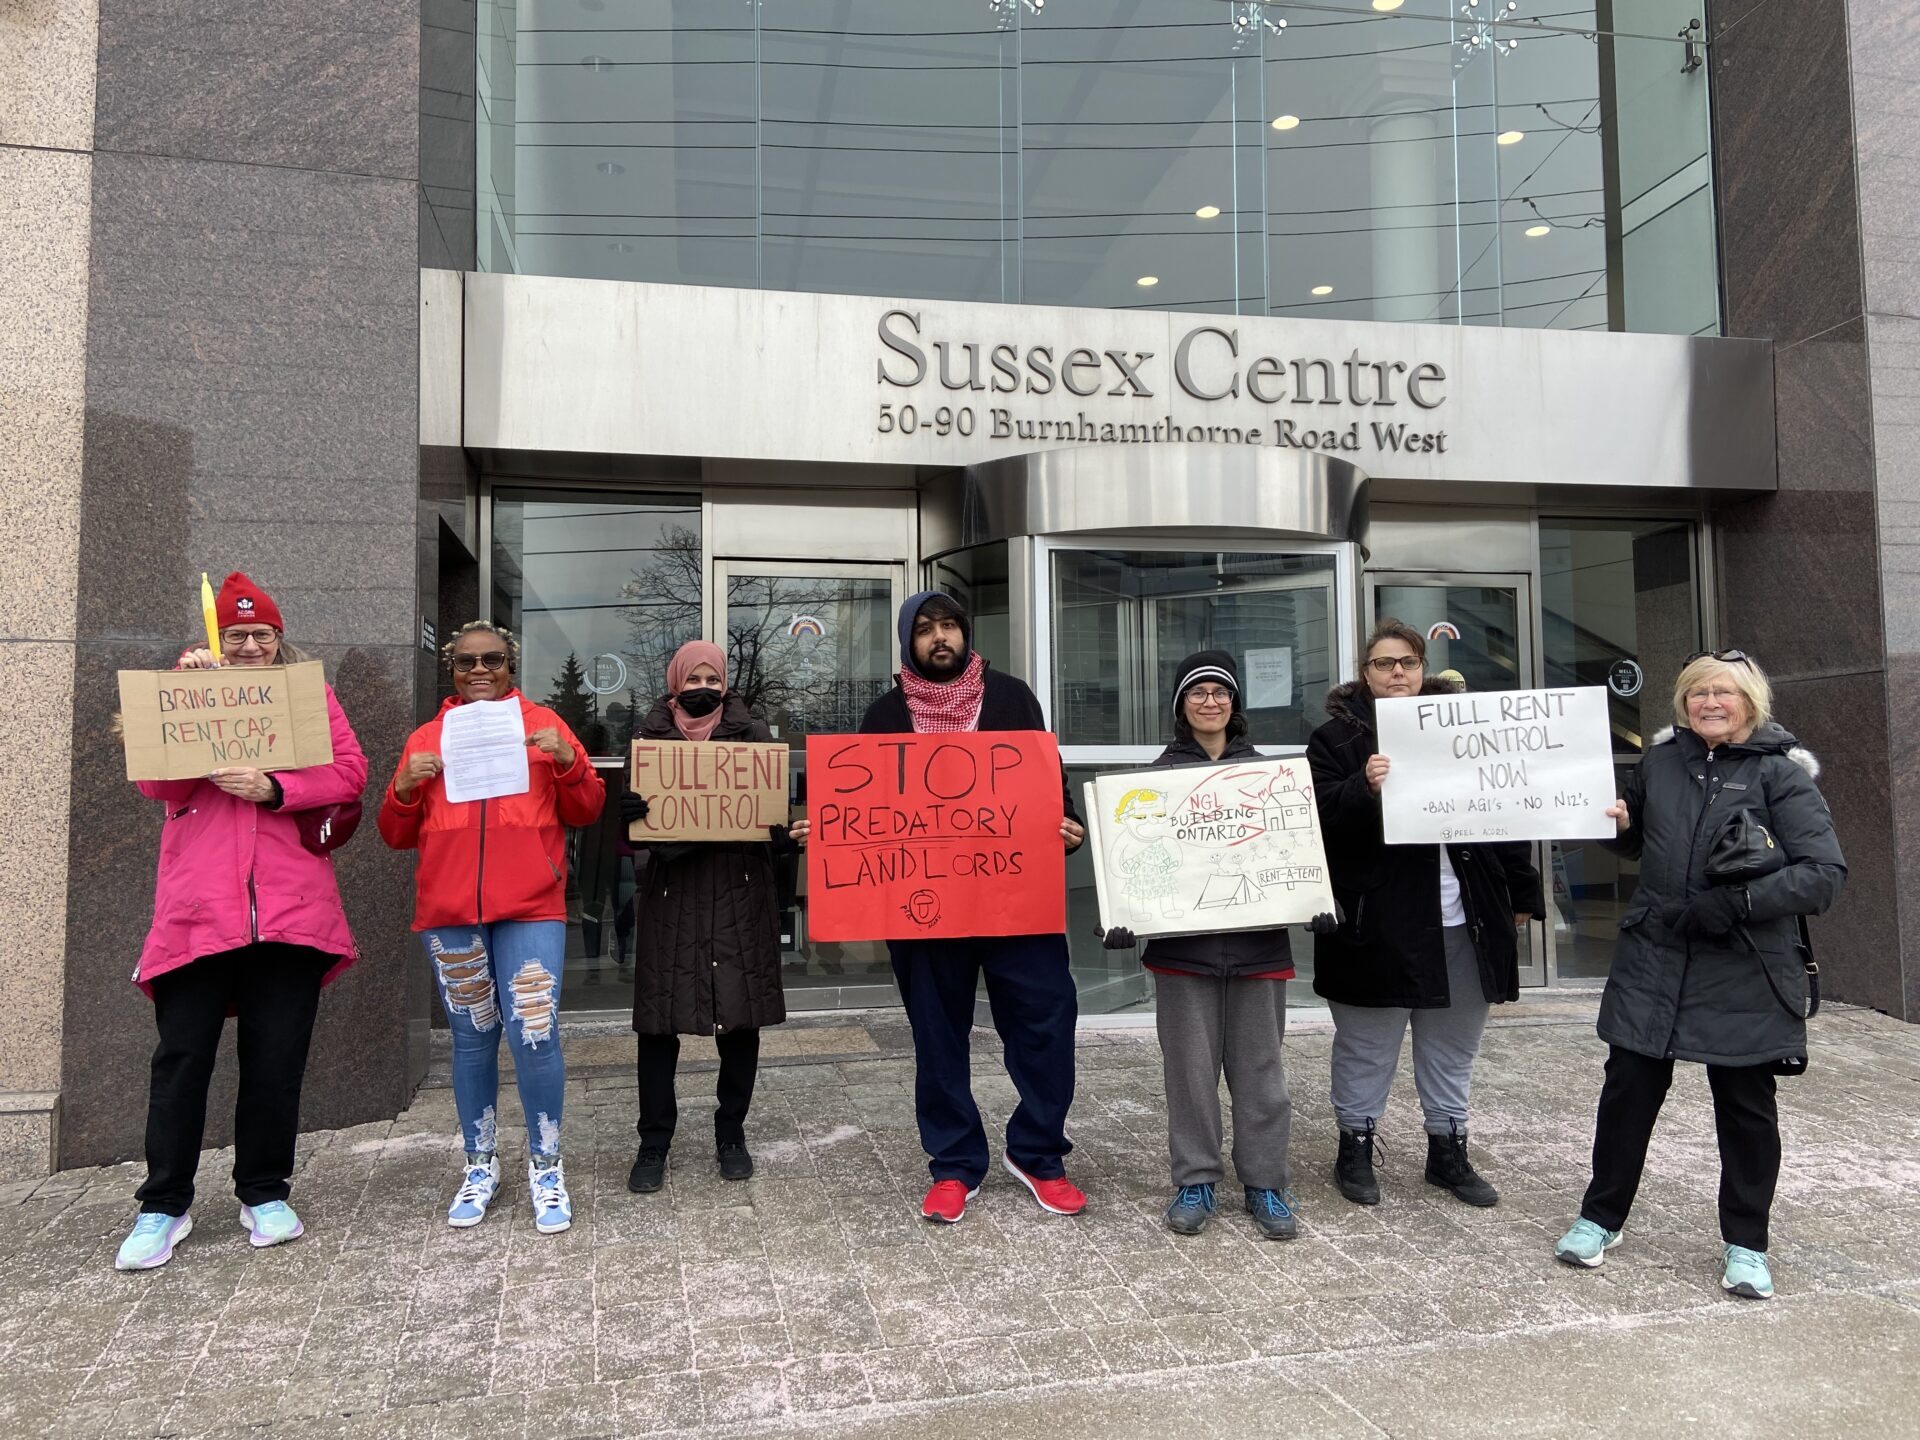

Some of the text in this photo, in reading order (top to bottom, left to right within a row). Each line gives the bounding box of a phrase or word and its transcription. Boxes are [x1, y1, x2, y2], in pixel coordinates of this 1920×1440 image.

[877, 309, 1447, 409] Sussex Centre
[877, 403, 977, 436] 50-90
[1274, 418, 1362, 451] Road
[1369, 421, 1449, 453] West
[158, 685, 274, 713] BRING BACK
[1417, 692, 1576, 731] FULL RENT
[161, 716, 273, 745] RENT CAP
[1452, 725, 1564, 760] CONTROL
[636, 745, 788, 791] FULL RENT
[827, 742, 1023, 800] STOP
[1478, 759, 1528, 791] NOW
[642, 793, 770, 831] CONTROL
[1189, 791, 1224, 810] NGL
[819, 803, 1018, 841] PREDATORY
[1176, 824, 1247, 842] ONTARIO
[823, 843, 1024, 889] LANDLORDS
[1258, 867, 1322, 884] RENT-A-TENT
